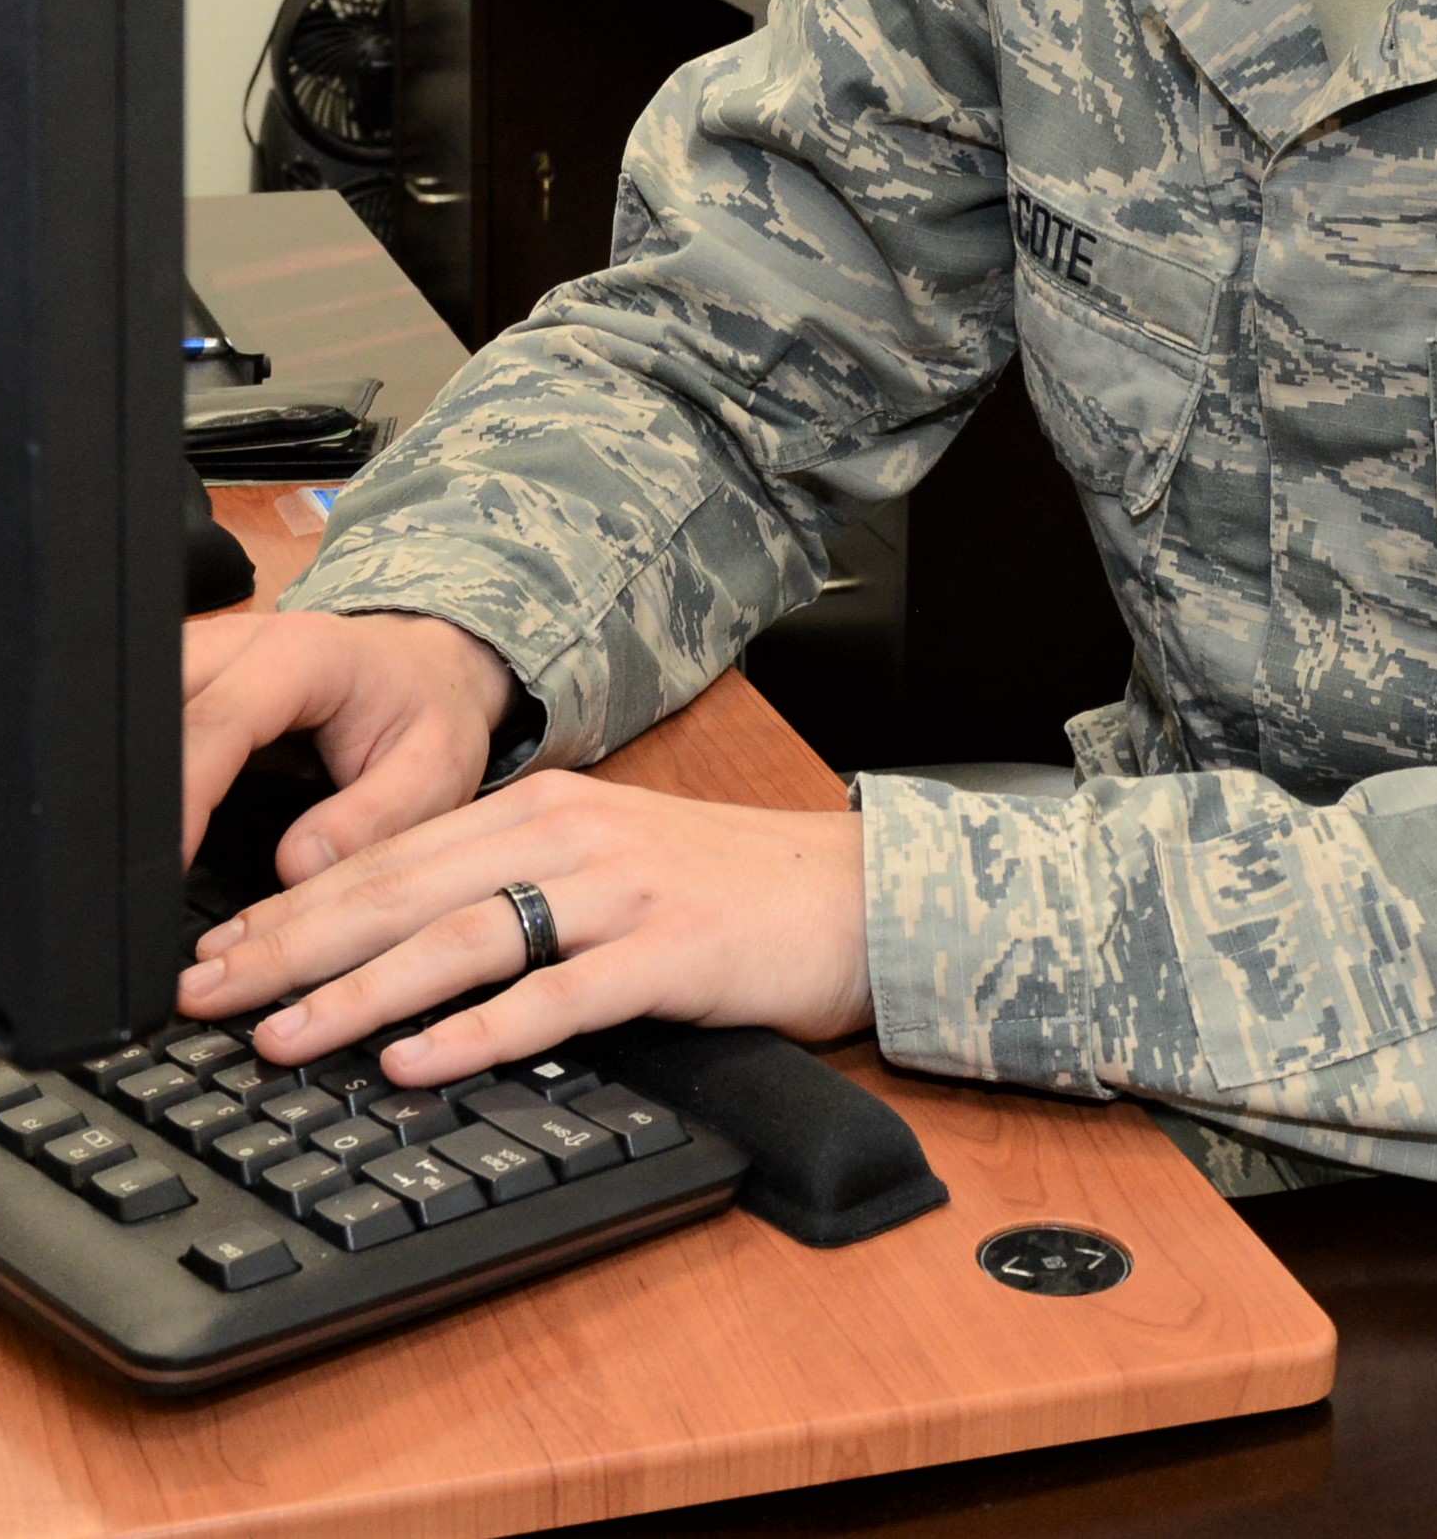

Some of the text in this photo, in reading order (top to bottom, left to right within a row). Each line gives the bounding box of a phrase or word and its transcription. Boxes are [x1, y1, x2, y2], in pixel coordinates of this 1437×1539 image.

[189, 1048, 214, 1062] R
[236, 1076, 263, 1090] E
[344, 1078, 368, 1091] S
[280, 1105, 309, 1120] W
[395, 1106, 420, 1120] A
[333, 1134, 359, 1150] Q
